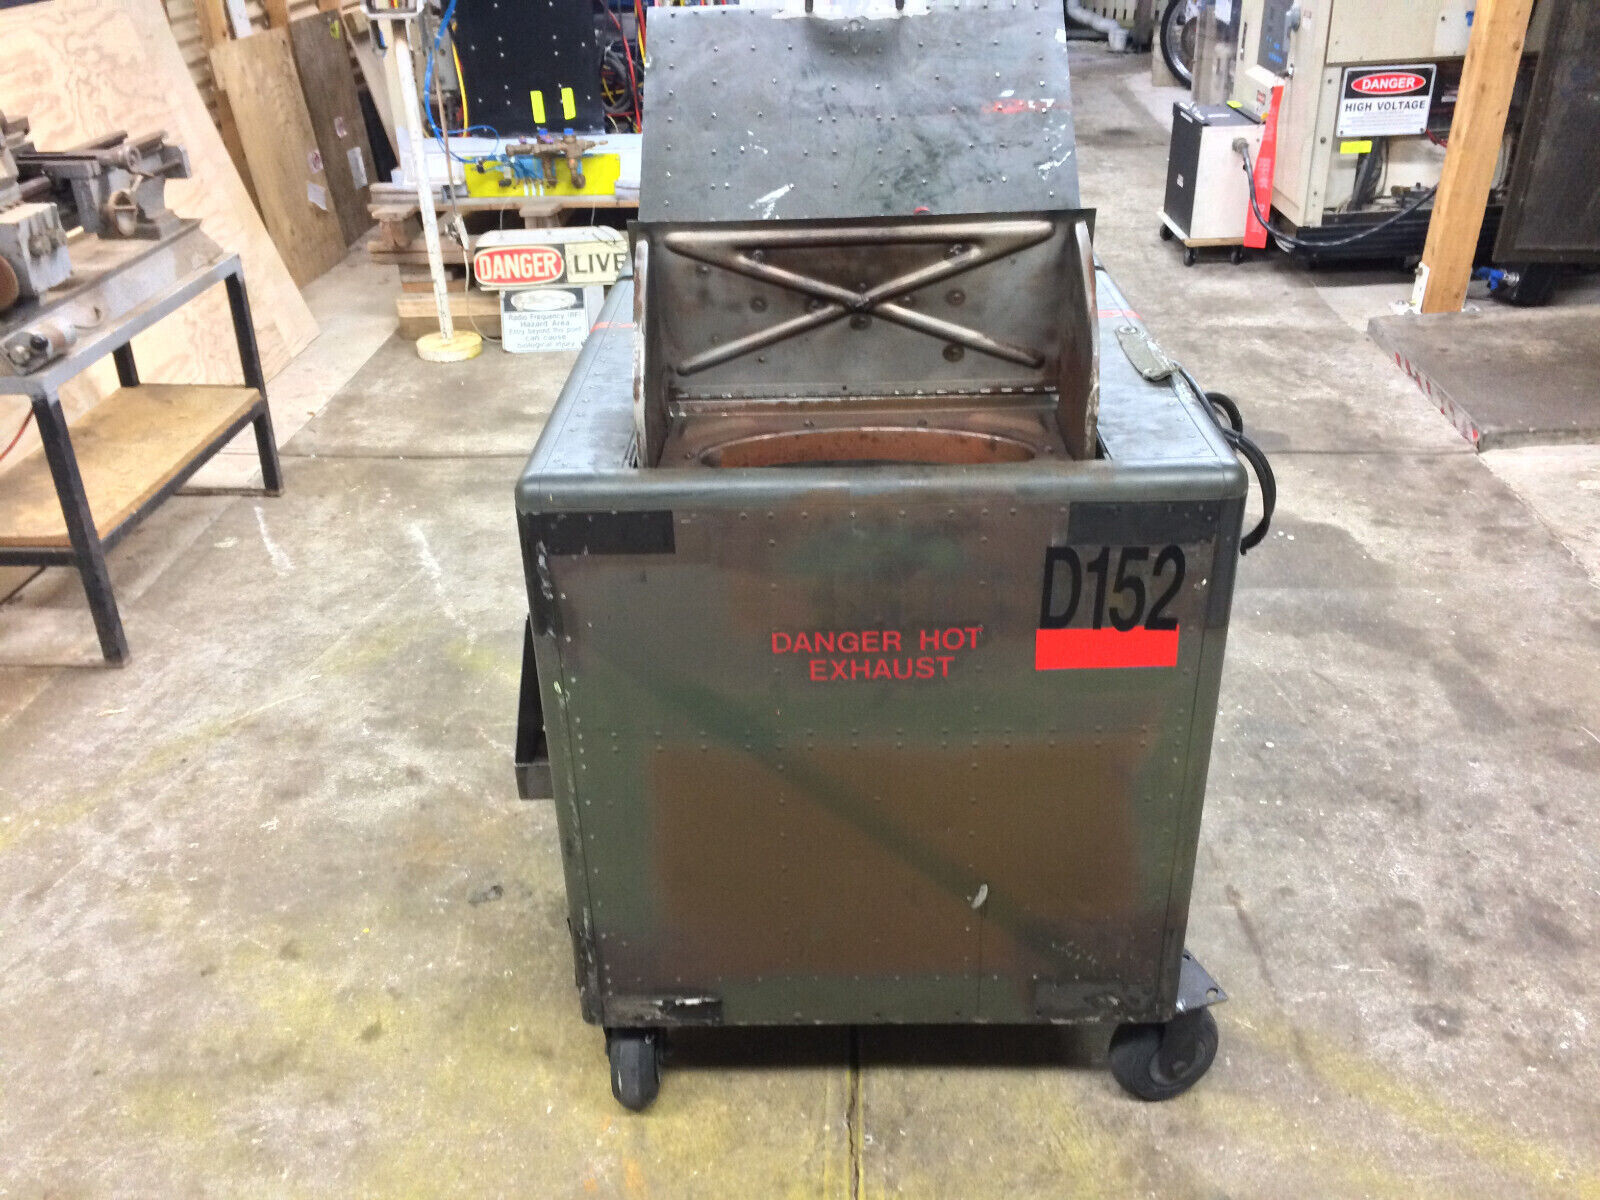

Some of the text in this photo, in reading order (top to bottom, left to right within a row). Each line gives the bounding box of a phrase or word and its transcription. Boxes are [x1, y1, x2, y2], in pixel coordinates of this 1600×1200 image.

[1362, 77, 1415, 90] DANGER
[1344, 99, 1426, 113] HIGH VOLTAGE
[479, 253, 626, 280] DANGER LIVE
[1040, 545, 1186, 632] D152
[770, 626, 984, 655] DANGER HOT
[809, 655, 956, 682] EXHAUST
